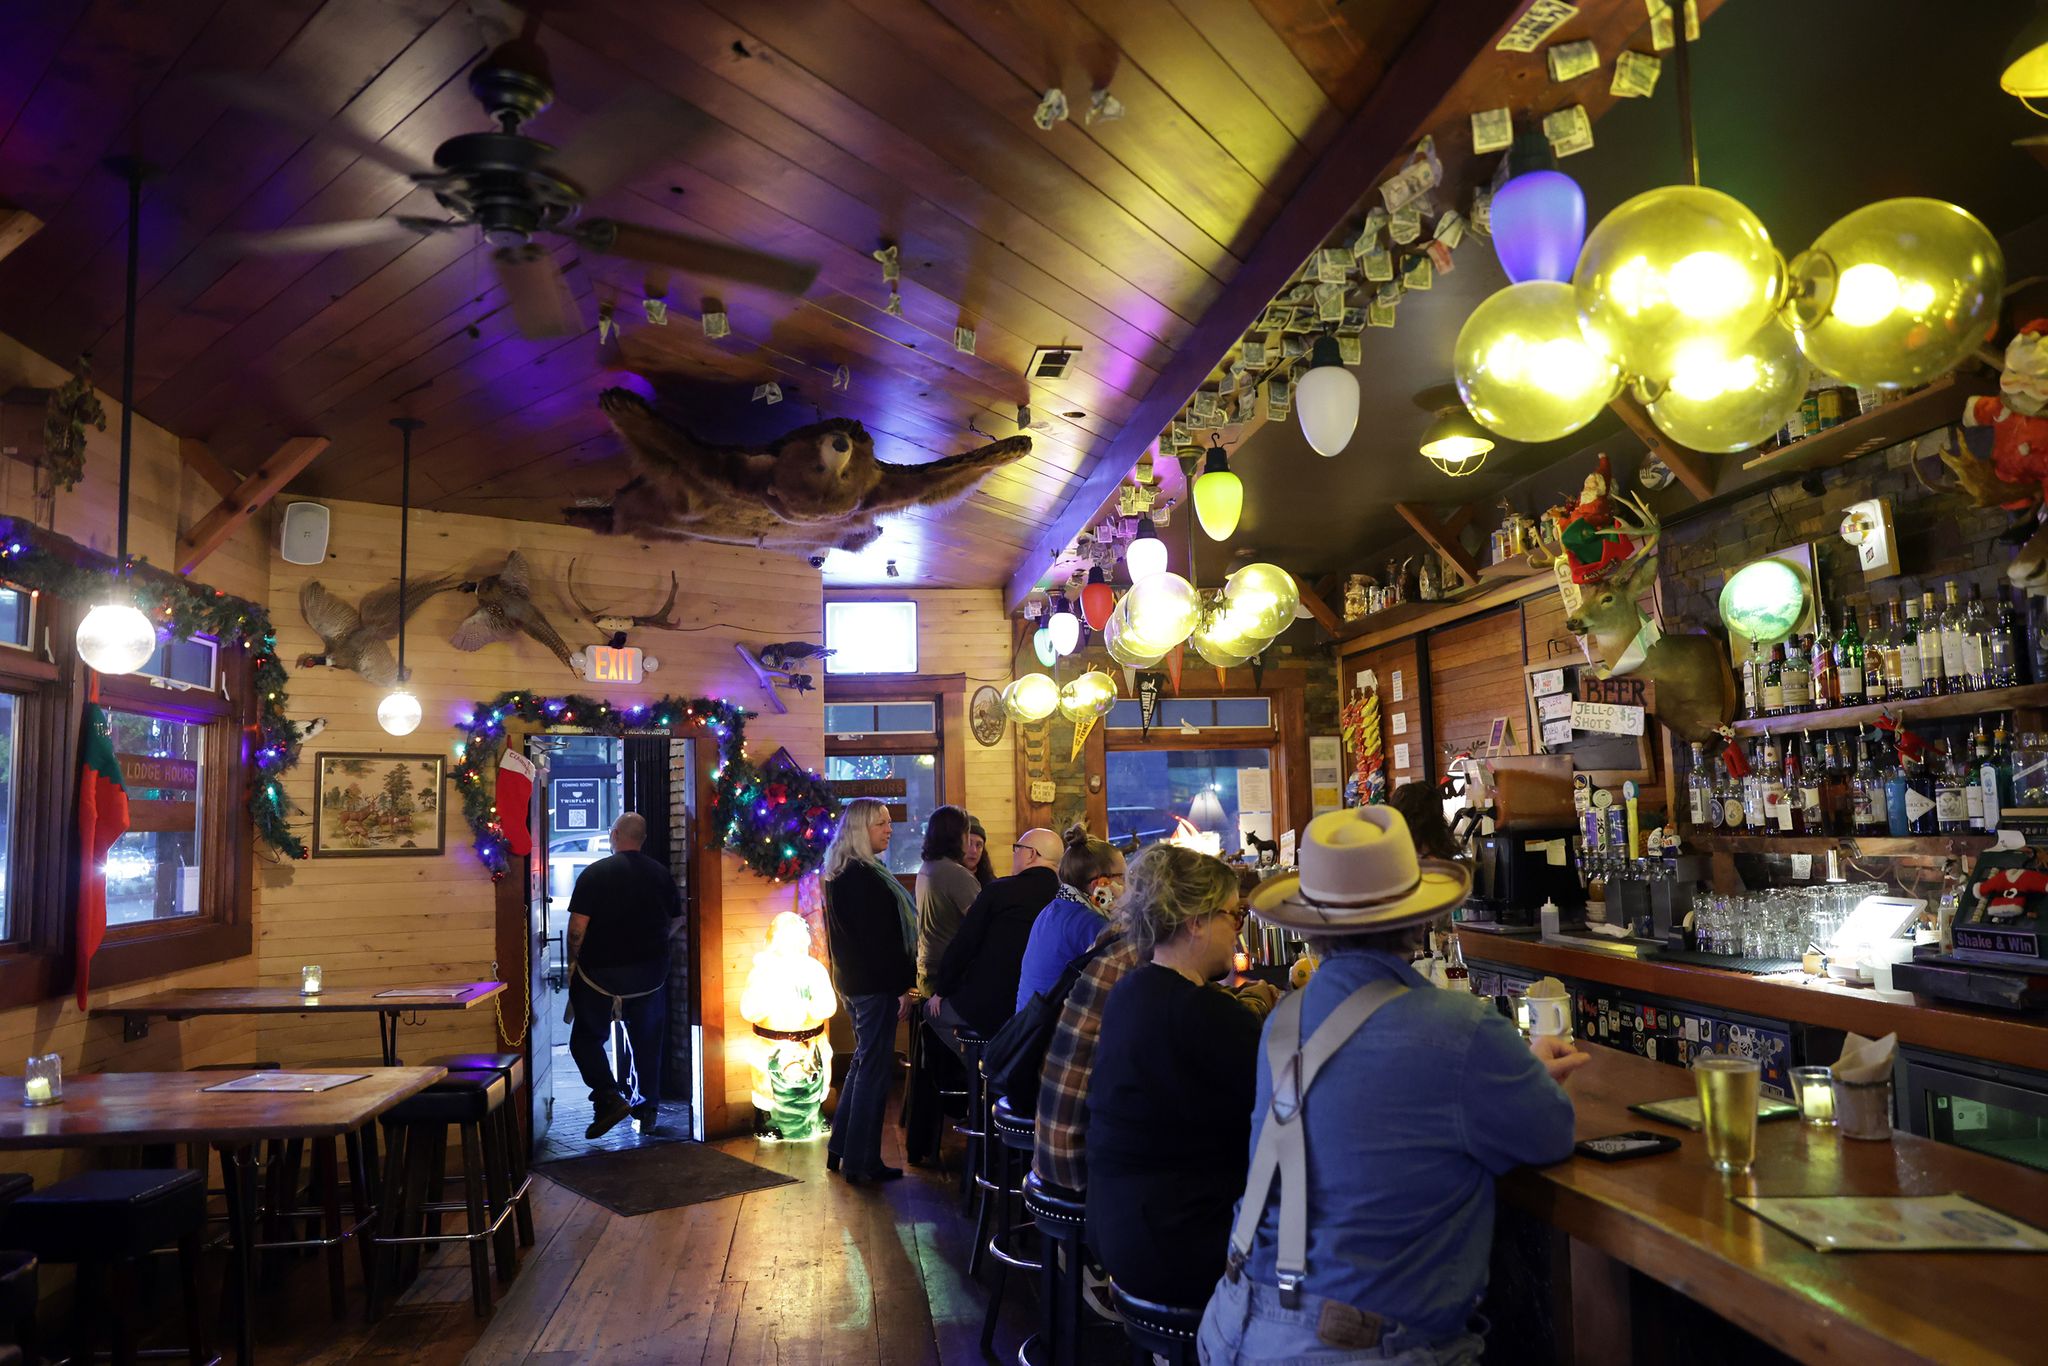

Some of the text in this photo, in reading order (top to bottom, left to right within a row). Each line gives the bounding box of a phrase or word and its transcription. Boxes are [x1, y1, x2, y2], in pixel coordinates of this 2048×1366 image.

[595, 647, 636, 680] EXIT
[1585, 678, 1648, 707] BEER
[1575, 703, 1615, 716] JELL-O
[1620, 707, 1637, 729] $5
[1574, 716, 1611, 730] SHOTS
[127, 762, 195, 782] LODGE HOURS
[864, 783, 903, 794] HOURS
[1957, 931, 2033, 953] Shake & Win
